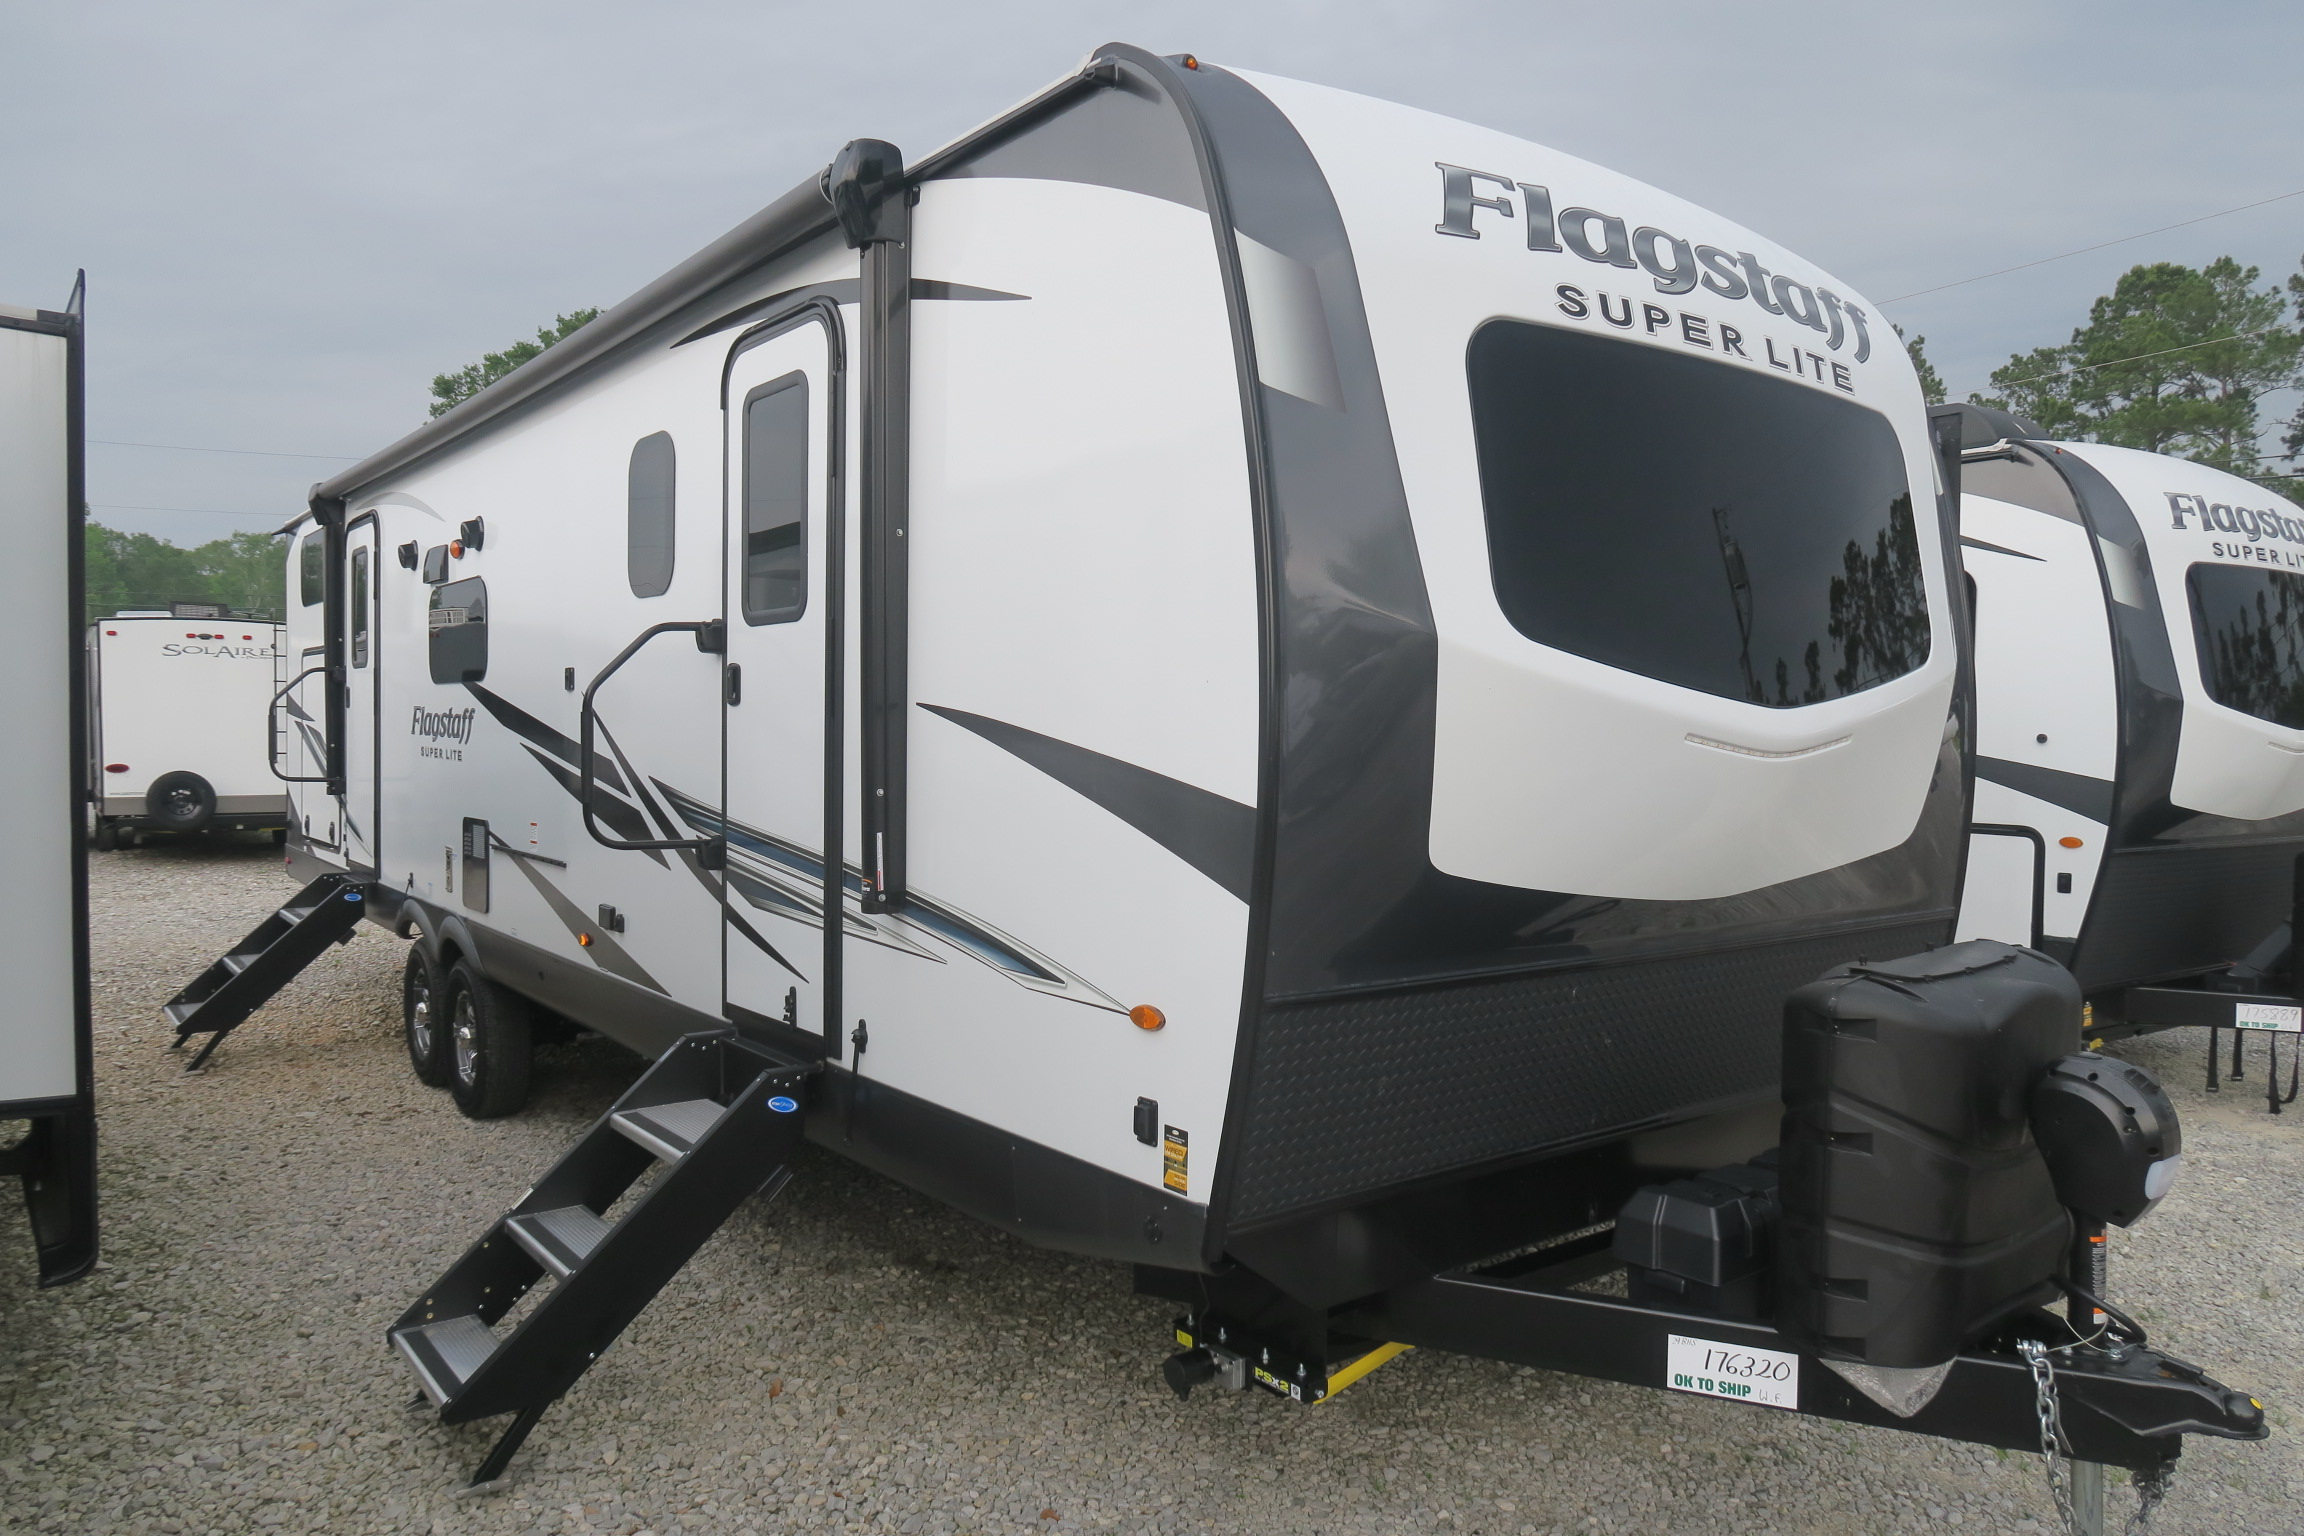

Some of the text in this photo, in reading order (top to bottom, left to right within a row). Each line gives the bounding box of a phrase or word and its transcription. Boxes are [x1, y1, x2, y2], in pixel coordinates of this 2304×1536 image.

[1434, 161, 1871, 365] Flagstaff
[1555, 283, 1855, 396] SUPER LITE
[2163, 491, 2304, 547] Flagsta
[2212, 542, 2281, 564] SUPER
[161, 643, 273, 659] SOLAIRE
[411, 705, 476, 745] Flagstaff
[420, 746, 463, 762] SUPER LITE
[2239, 1020, 2250, 1028] OK
[2245, 1007, 2299, 1021] 175889
[1703, 1348, 1791, 1381] 176320
[1674, 1373, 1752, 1397] OK TO SHIP
